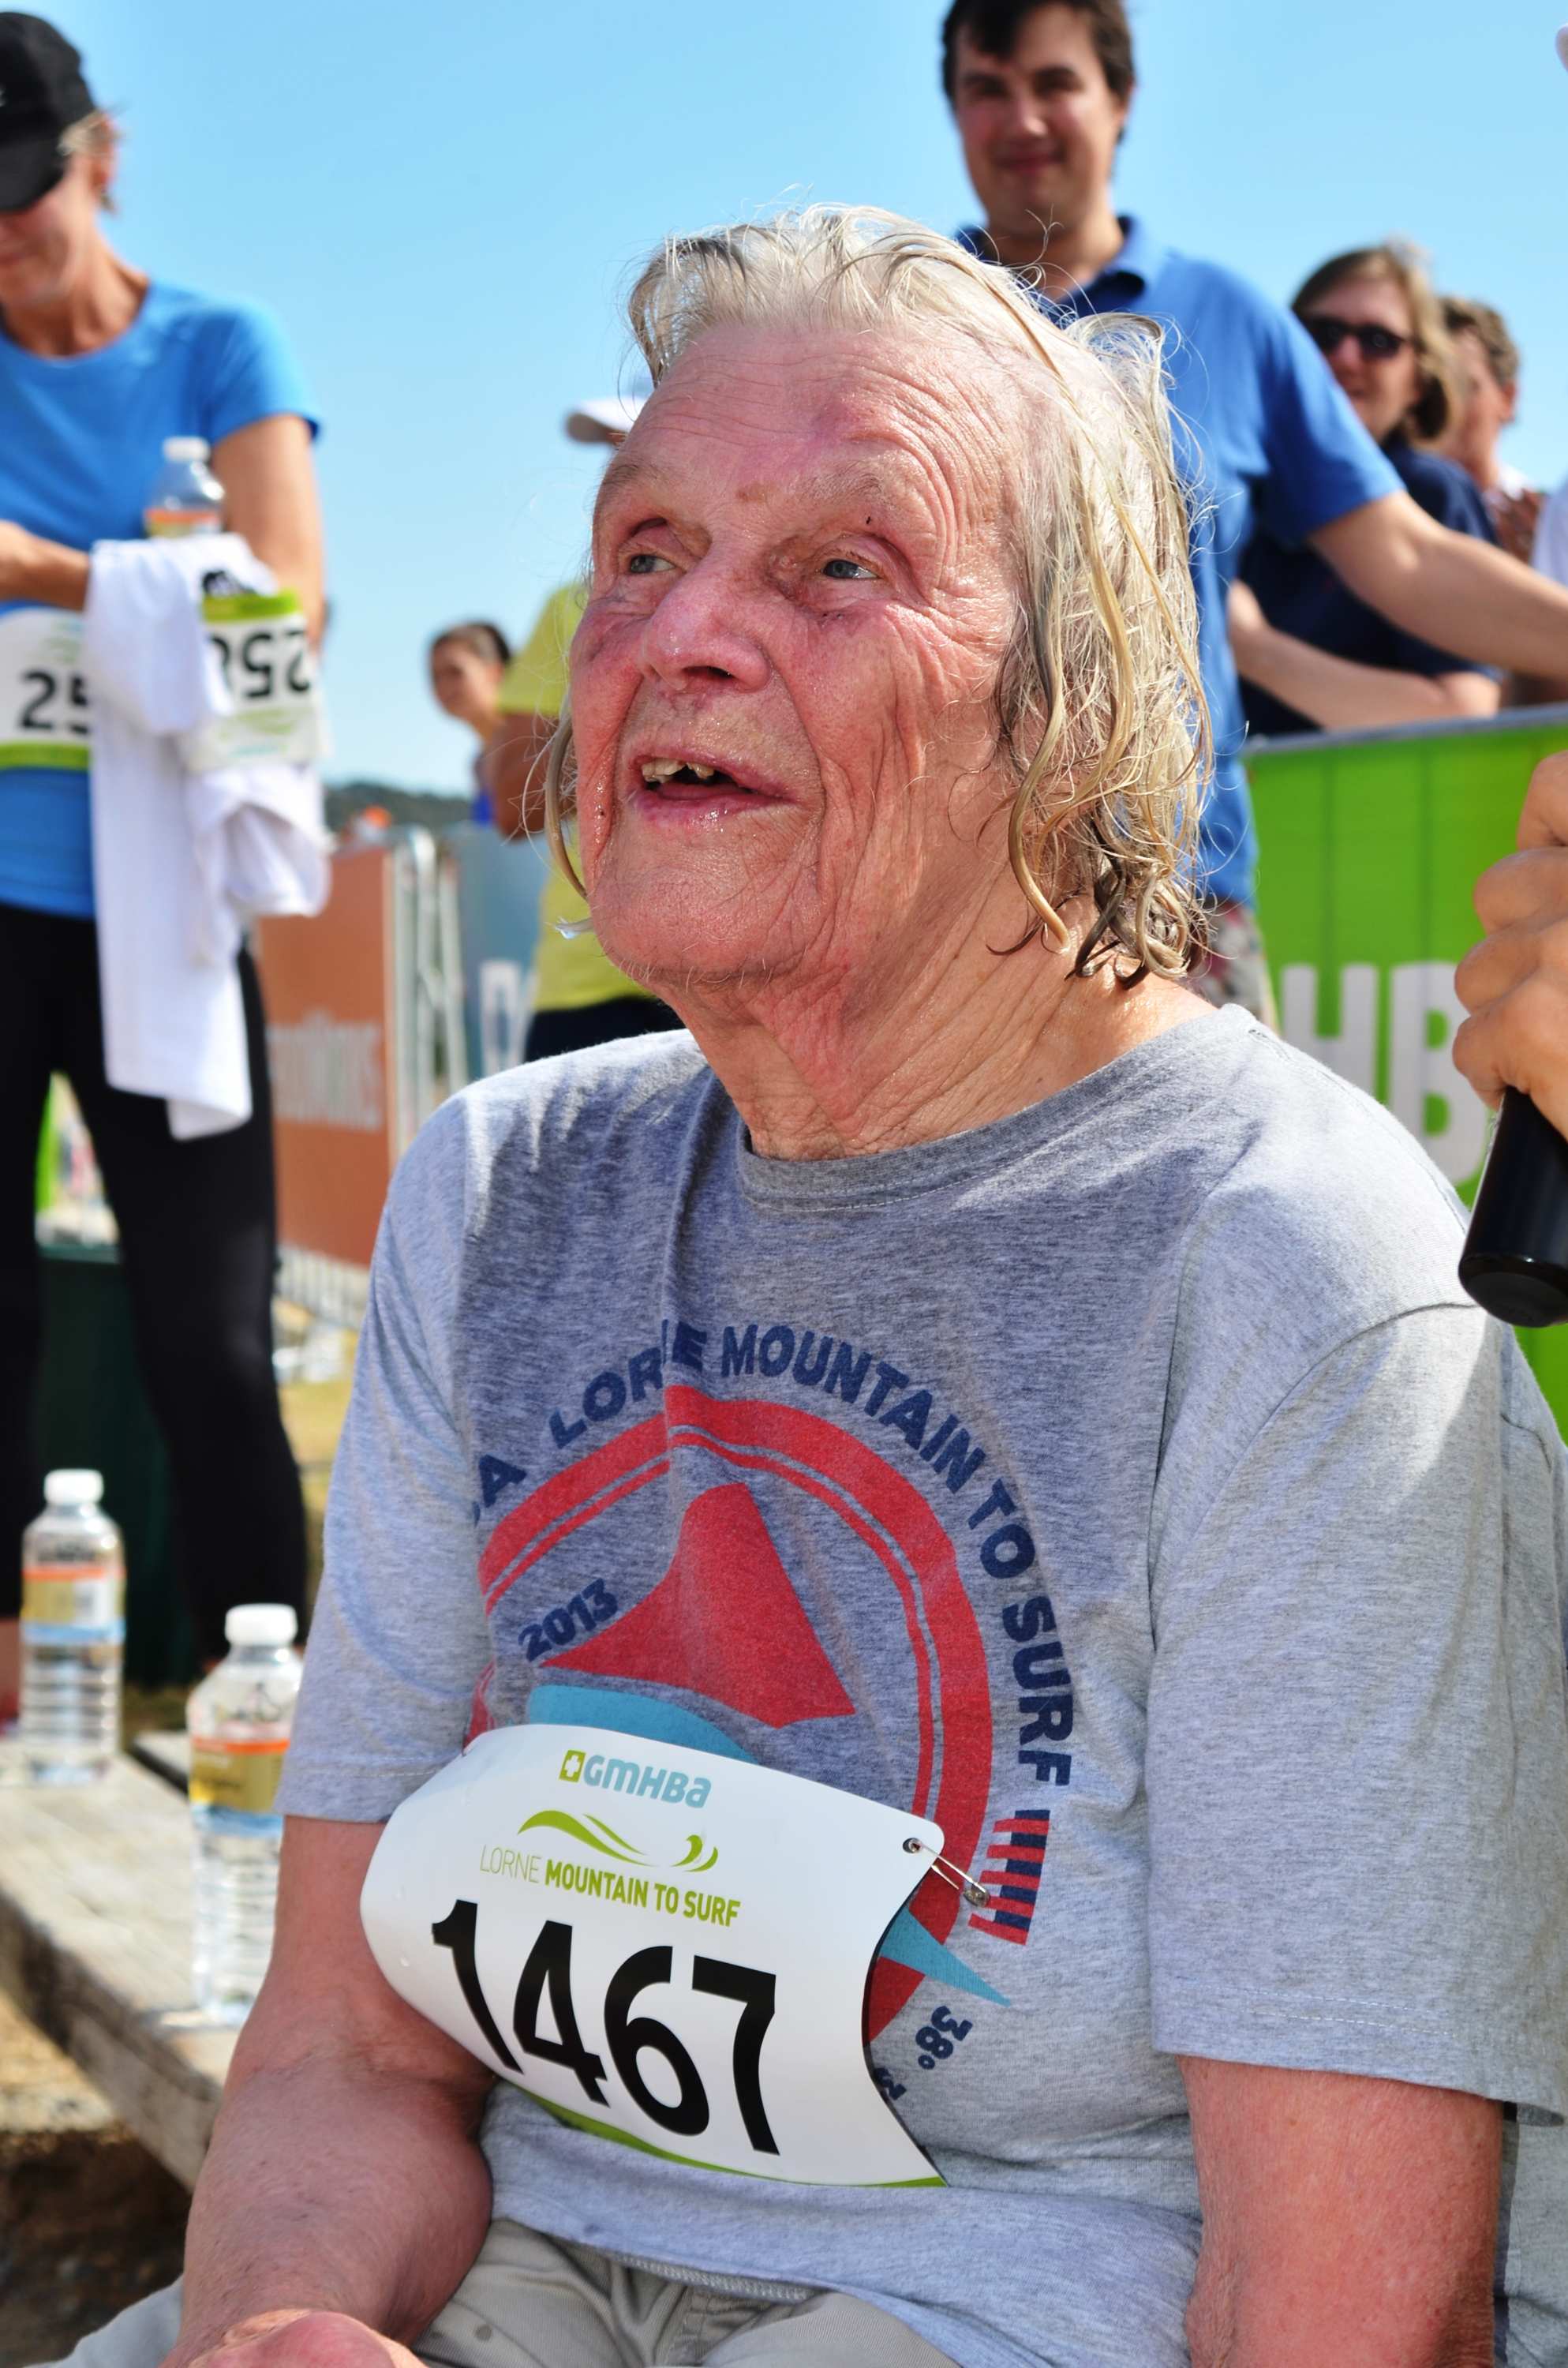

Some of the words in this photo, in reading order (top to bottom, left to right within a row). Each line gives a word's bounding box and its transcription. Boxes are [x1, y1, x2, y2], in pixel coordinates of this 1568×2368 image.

[472, 1455, 526, 1528] A
[549, 1319, 707, 1449] LORE
[721, 1325, 986, 1493] MOUNTAIN
[967, 1478, 1036, 1579] TO
[1002, 1596, 1074, 1785] SURF
[518, 1578, 618, 1662] 2013
[479, 1845, 542, 1884] LORNE
[544, 1859, 649, 1909] MOUNTAIN
[654, 1883, 679, 1915] TO
[683, 1890, 741, 1927] SURF
[432, 1899, 780, 2156] 1467
